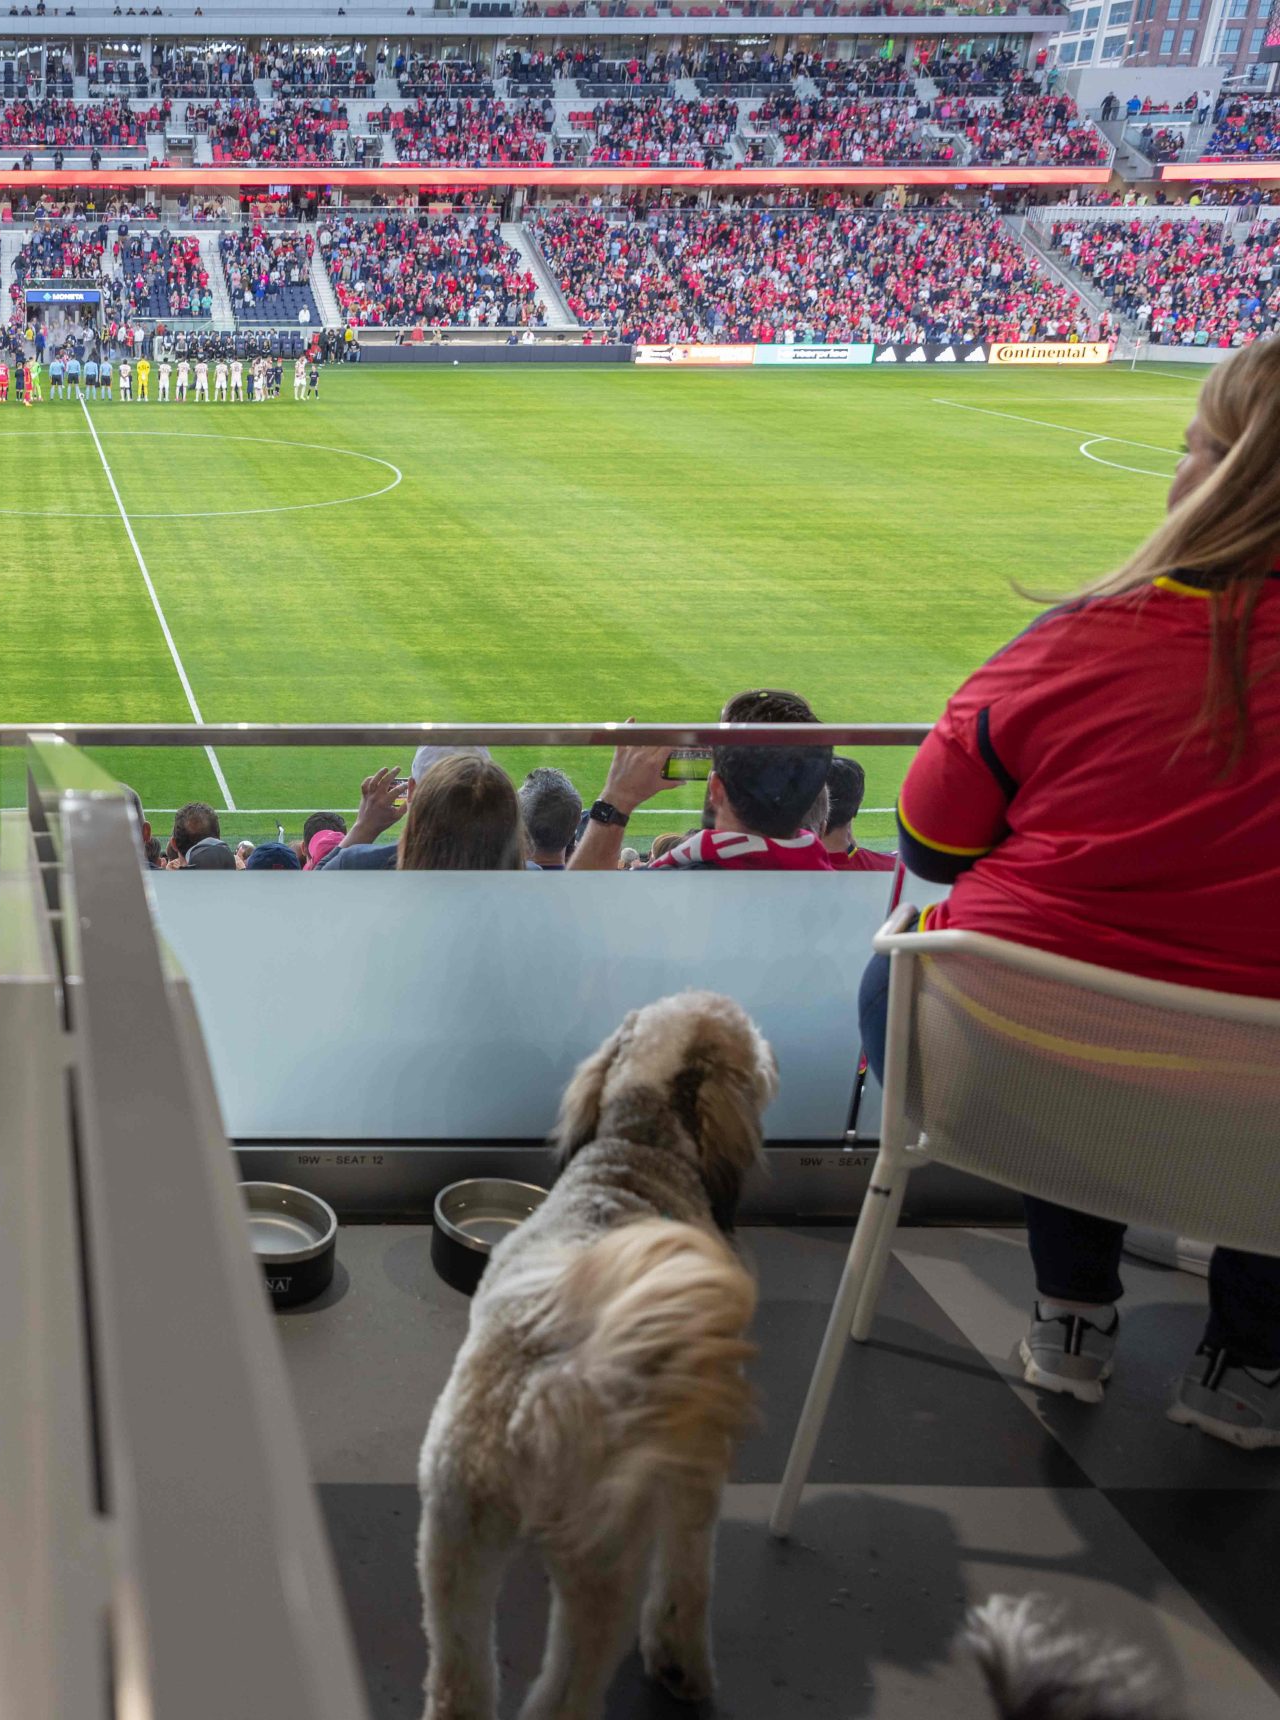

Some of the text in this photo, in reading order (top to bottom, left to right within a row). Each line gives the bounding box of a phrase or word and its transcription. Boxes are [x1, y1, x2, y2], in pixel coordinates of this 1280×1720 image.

[997, 346, 1086, 361] Continental
[298, 1155, 320, 1165] 19W
[336, 1155, 367, 1165] SEAT
[373, 1155, 384, 1165] 12
[800, 1157, 823, 1166] 19W
[839, 1157, 869, 1166] SEAT
